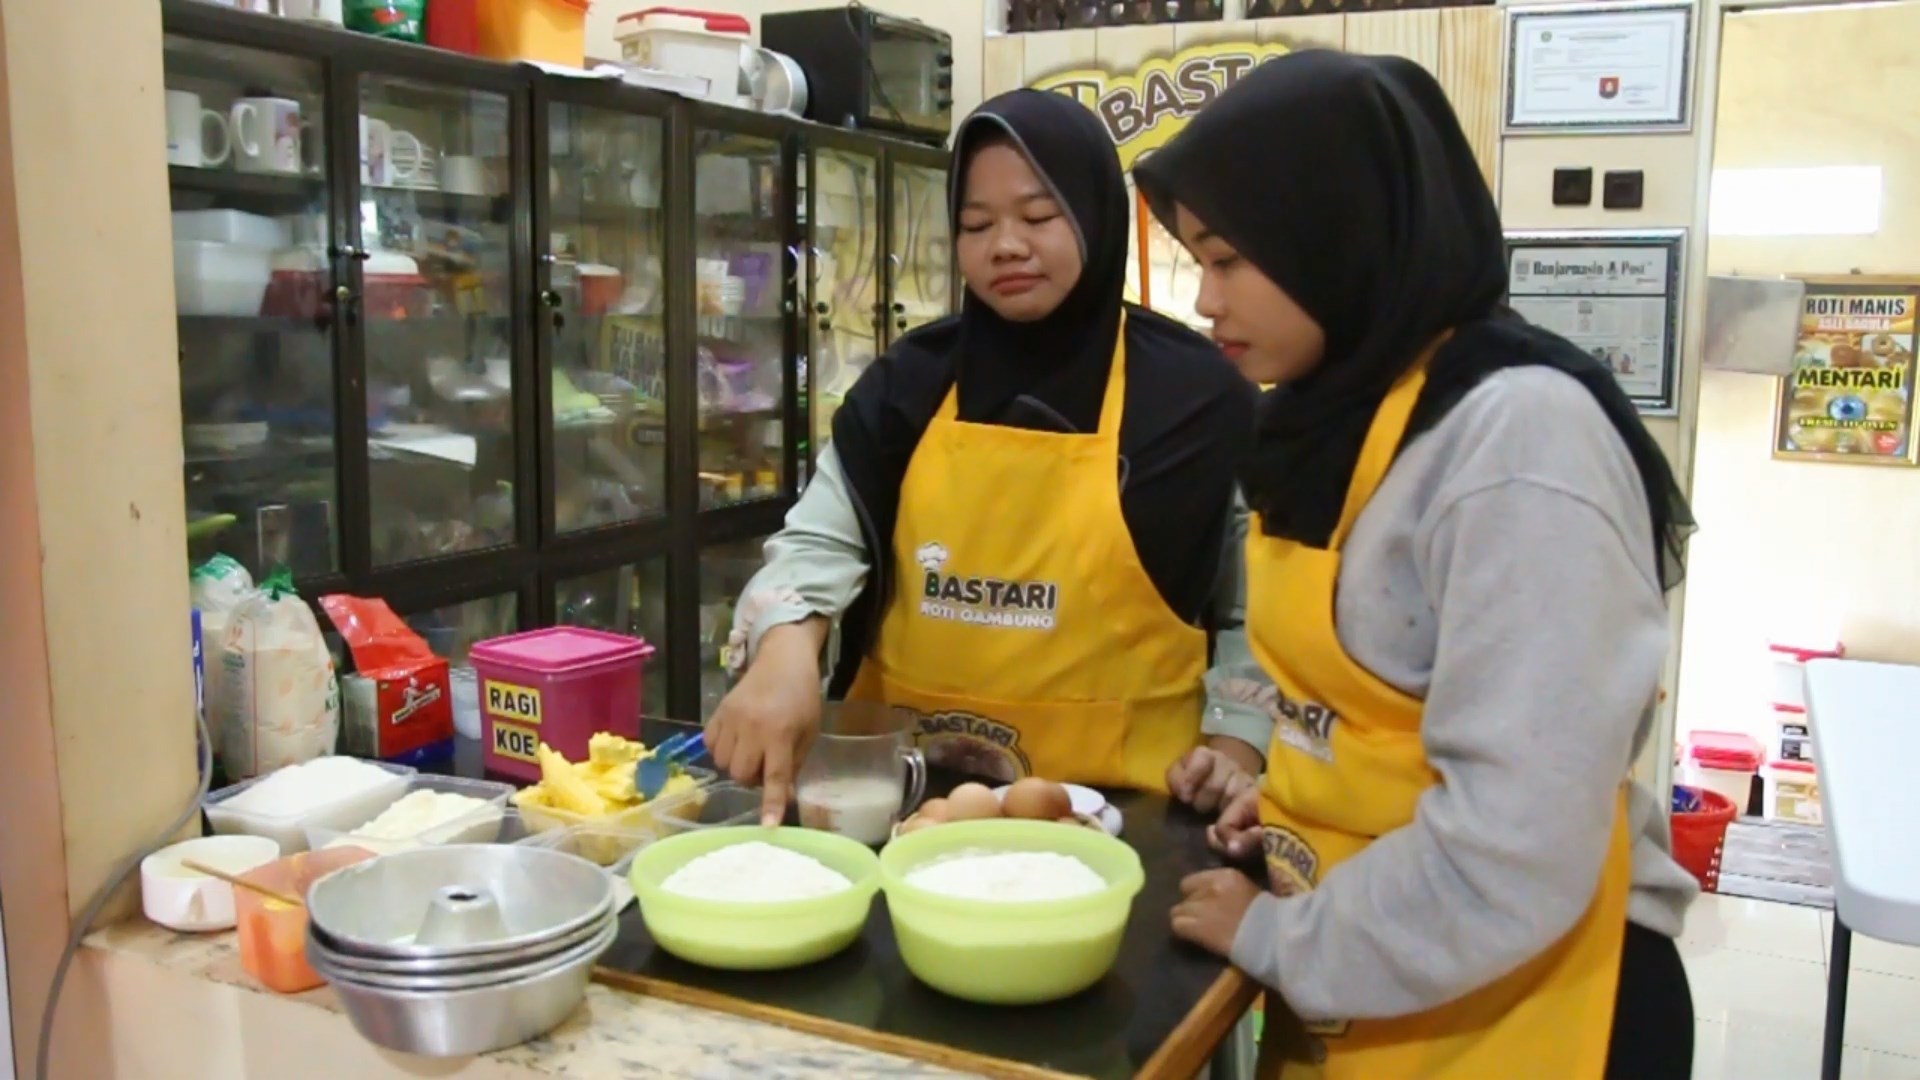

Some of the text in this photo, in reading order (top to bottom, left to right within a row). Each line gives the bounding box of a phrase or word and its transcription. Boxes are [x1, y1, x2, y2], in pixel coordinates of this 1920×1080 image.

[1100, 56, 1260, 142] BAST
[1533, 261, 1645, 278] Banjarmasin Post
[1806, 299, 1905, 315] ROTI MANIS
[1797, 369, 1901, 389] MENTARI
[925, 571, 1056, 610] BASTARI
[920, 603, 1053, 629] ROTI GAMBUNG
[489, 686, 538, 717] RAGI
[496, 728, 535, 757] KOE
[1263, 830, 1315, 880] STARI
